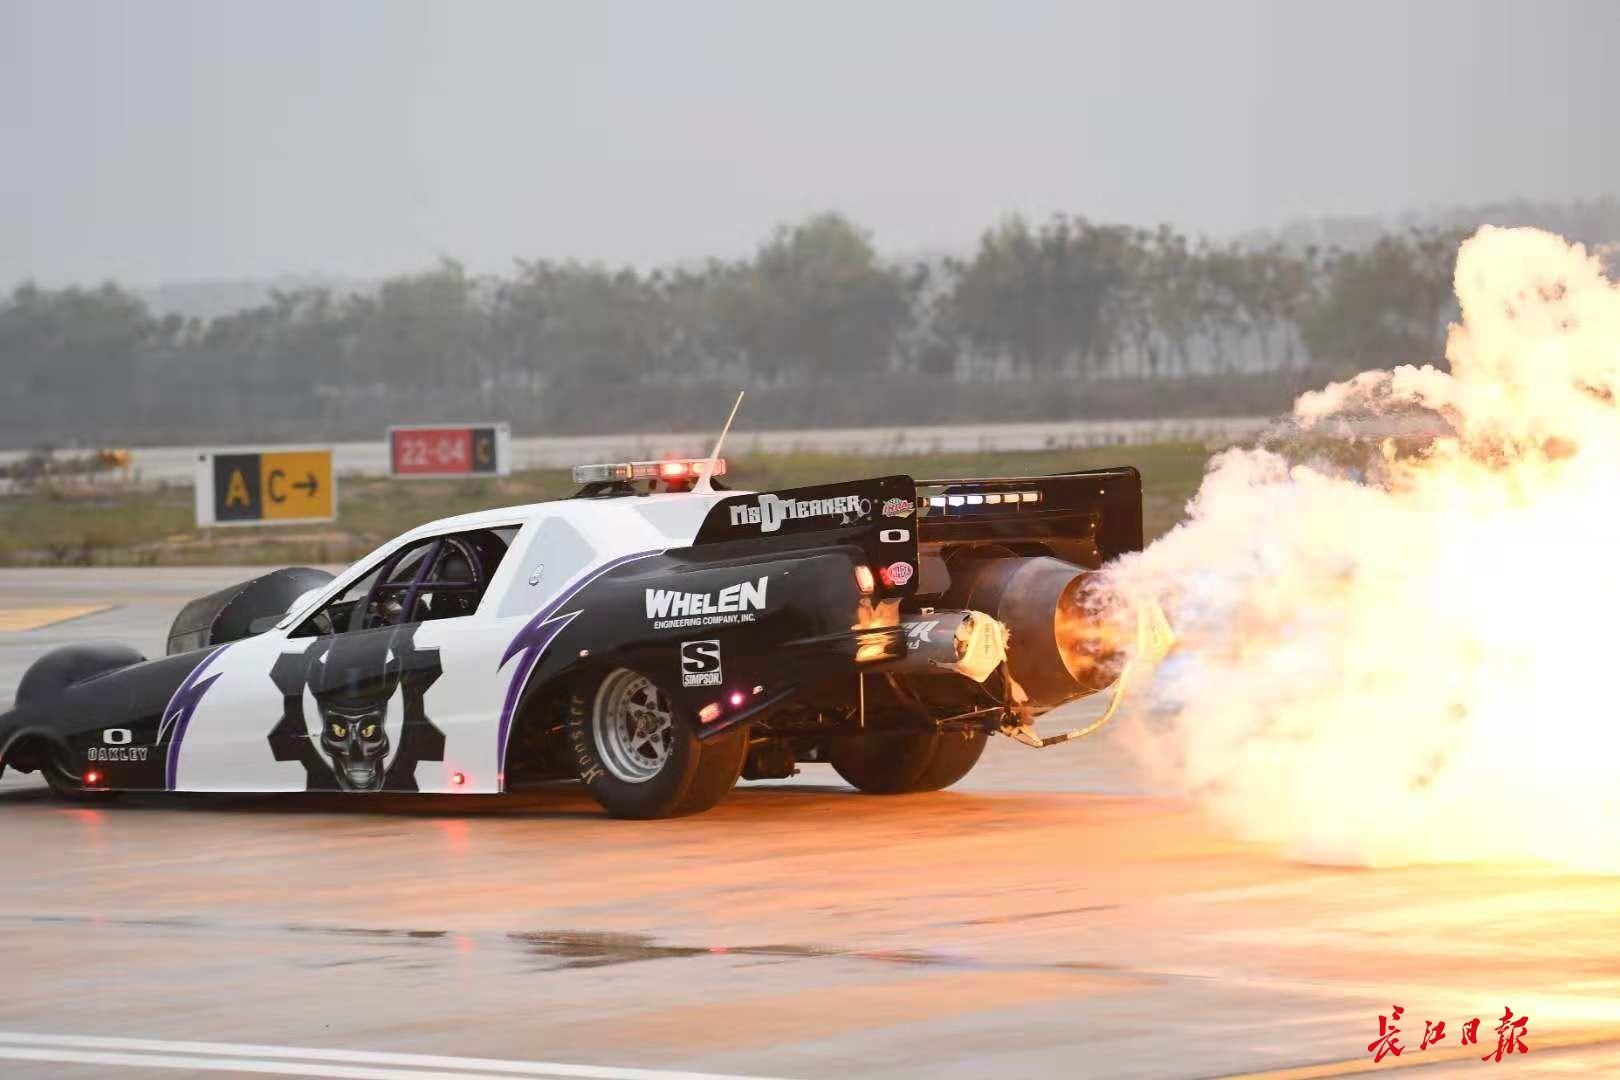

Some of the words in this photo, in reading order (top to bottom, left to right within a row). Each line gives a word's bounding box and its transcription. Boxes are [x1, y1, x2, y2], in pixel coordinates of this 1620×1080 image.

[402, 438, 465, 464] 22-04
[476, 437, 490, 463] C
[224, 468, 250, 509] A
[268, 469, 288, 503] C
[645, 576, 768, 619] WHELEN
[653, 617, 701, 629] ENGINEERING
[702, 615, 740, 625] COMPANY,
[741, 613, 756, 623] INC.
[87, 747, 148, 761] OAKLEY
